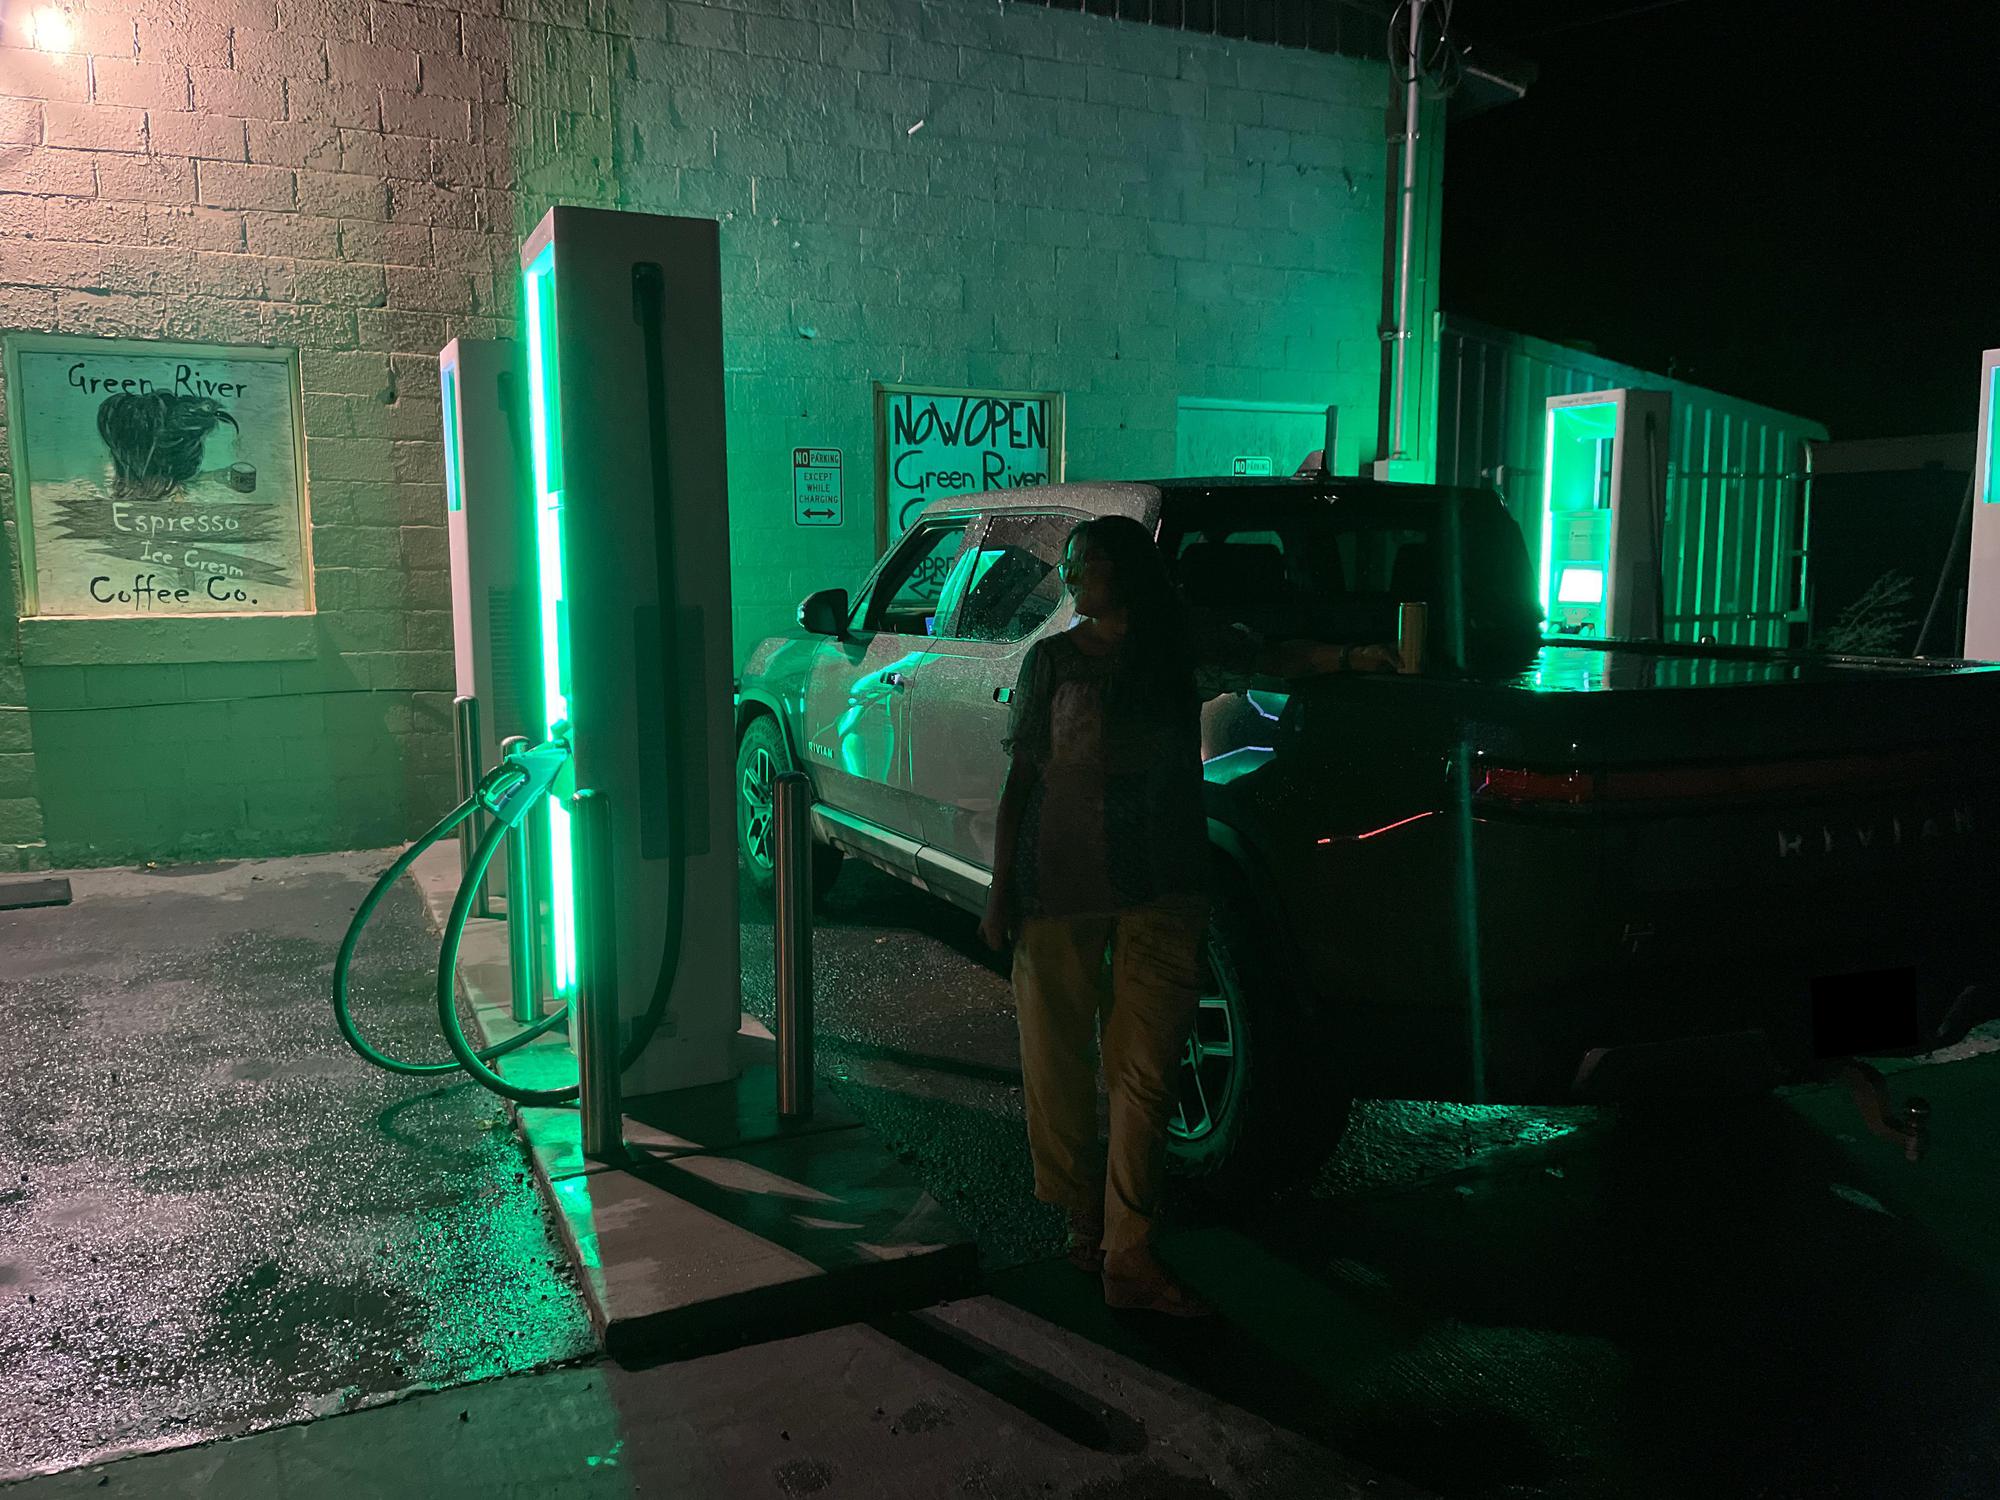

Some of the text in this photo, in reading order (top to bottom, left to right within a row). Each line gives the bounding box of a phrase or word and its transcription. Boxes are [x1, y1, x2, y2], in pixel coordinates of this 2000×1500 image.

[68, 363, 248, 399] Green River
[895, 395, 1046, 449] NOW OPEN
[796, 452, 839, 465] NO PARKING
[1235, 461, 1245, 473] NO
[804, 472, 832, 481] EXCEPT
[894, 450, 1047, 494] Green River
[799, 495, 838, 504] CHARGING
[807, 484, 830, 493] WHILE
[112, 503, 239, 537] Espresso
[139, 541, 244, 577] Ice Cream
[90, 574, 258, 611] Coffee Co.
[808, 741, 834, 759] RIVIAN
